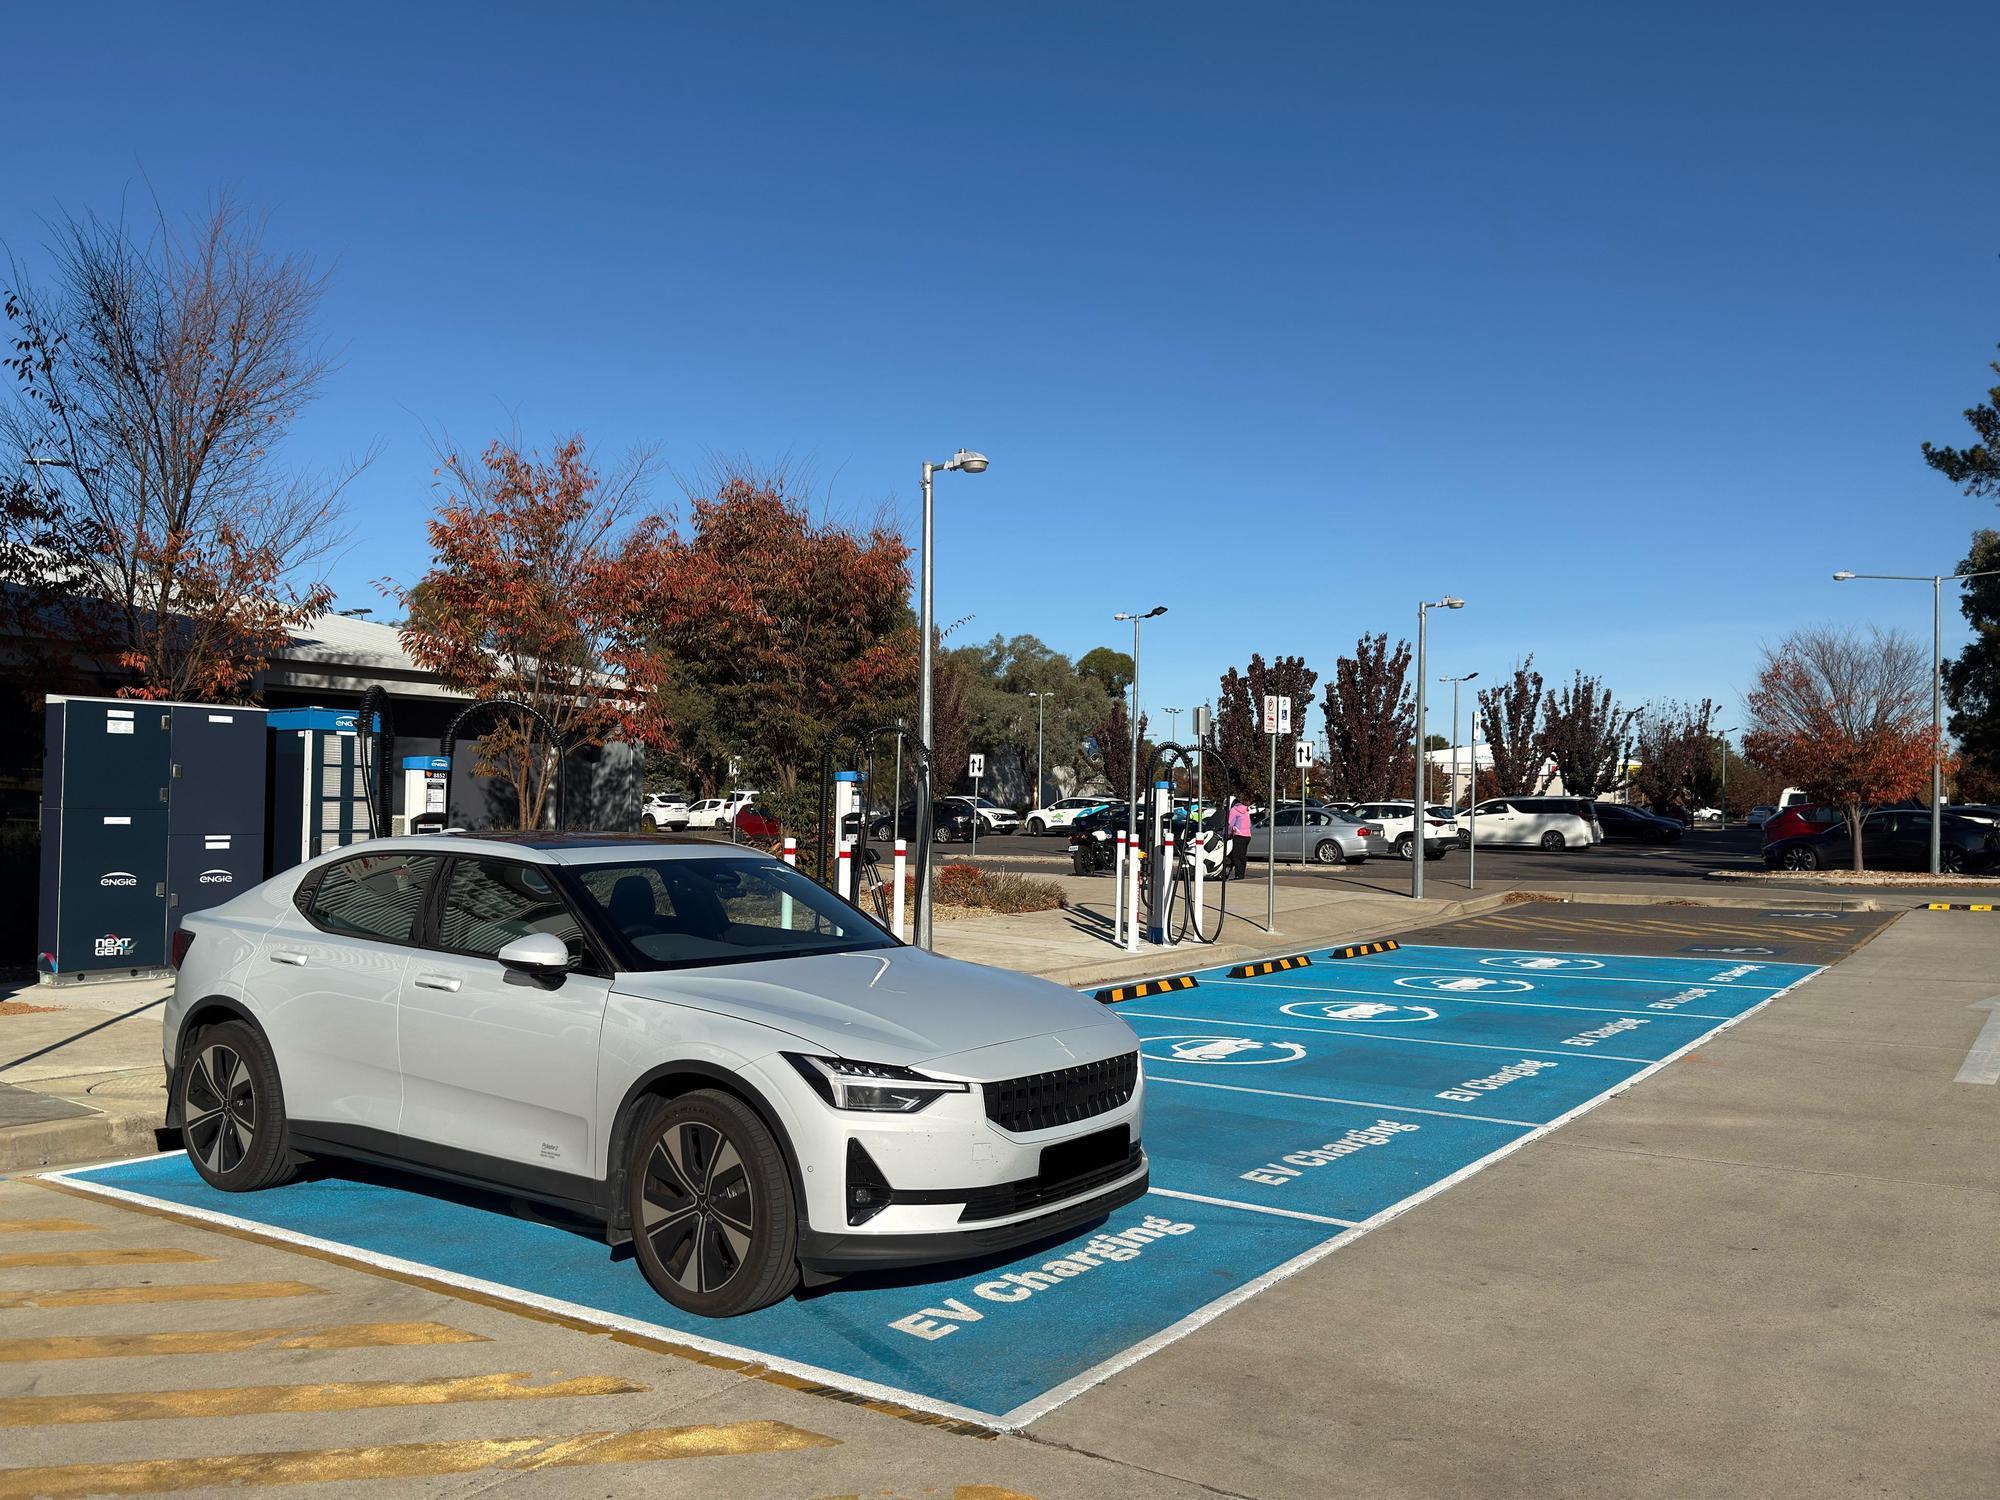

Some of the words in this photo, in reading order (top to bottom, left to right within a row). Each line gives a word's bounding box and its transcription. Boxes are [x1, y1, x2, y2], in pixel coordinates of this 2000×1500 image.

[1560, 1035, 1599, 1047] EV
[1579, 1017, 1651, 1040] Charging
[1434, 1090, 1483, 1103] EV
[1464, 1059, 1559, 1091] Charging
[1239, 1163, 1303, 1186] EV
[1283, 1119, 1421, 1167] Charging
[887, 1298, 984, 1341] EV
[972, 1214, 1196, 1303] Charging
